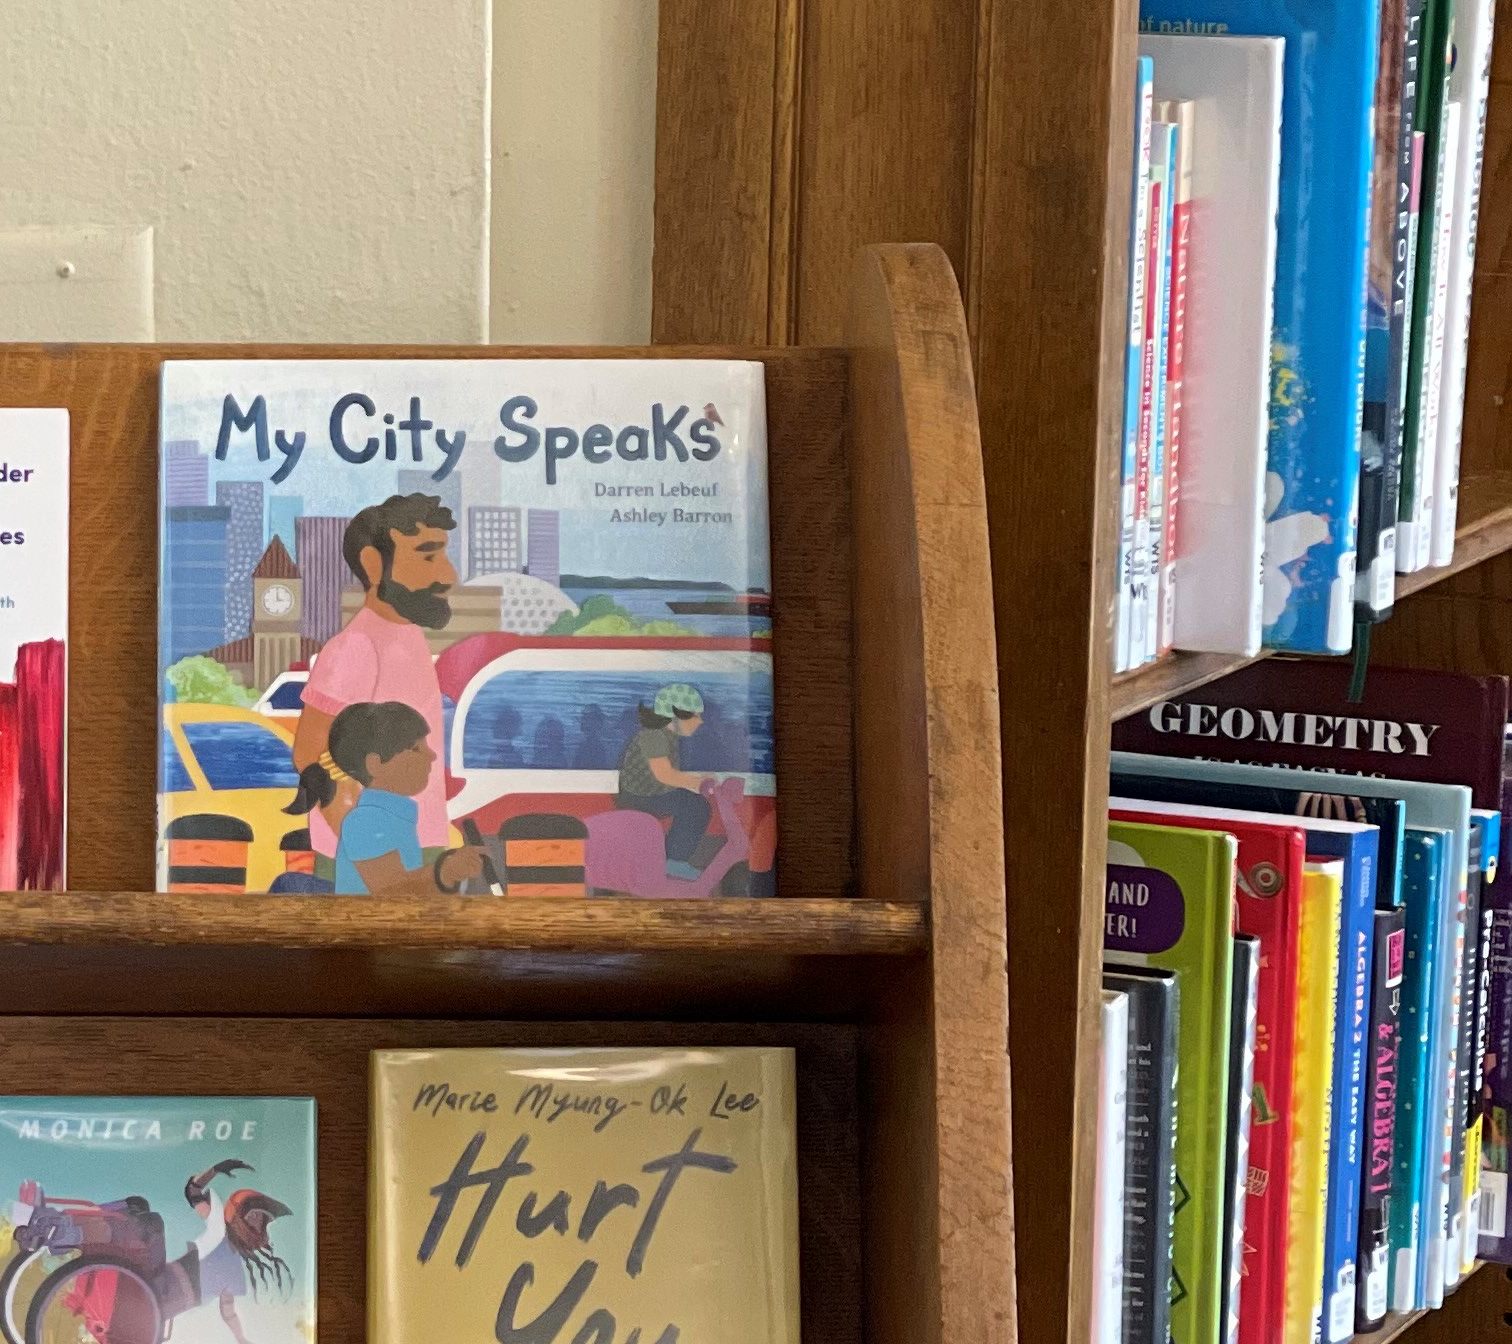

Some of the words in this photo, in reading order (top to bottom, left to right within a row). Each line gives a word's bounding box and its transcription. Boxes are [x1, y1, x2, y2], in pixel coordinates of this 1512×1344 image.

[1159, 18, 1228, 34] nature
[1406, 15, 1420, 98] LIFE
[1394, 182, 1410, 315] ABOVE
[215, 394, 307, 485] My
[329, 392, 465, 482] City
[595, 482, 654, 498] Darren
[660, 482, 719, 498] Lebeuf
[610, 509, 668, 527] Ashley
[673, 509, 733, 524] Barron
[1149, 701, 1440, 756] GEOMETRY
[1109, 881, 1149, 906] AND
[1355, 931, 1366, 1028] ALGEBRA
[1352, 1048, 1360, 1081] THE
[413, 1084, 499, 1115] Marie
[711, 1081, 760, 1119] Lee
[1372, 1046, 1394, 1176] ALGEBRA
[19, 1119, 162, 1141] MONICA
[189, 1120, 257, 1141] ROE
[417, 1128, 738, 1279] Hurt
